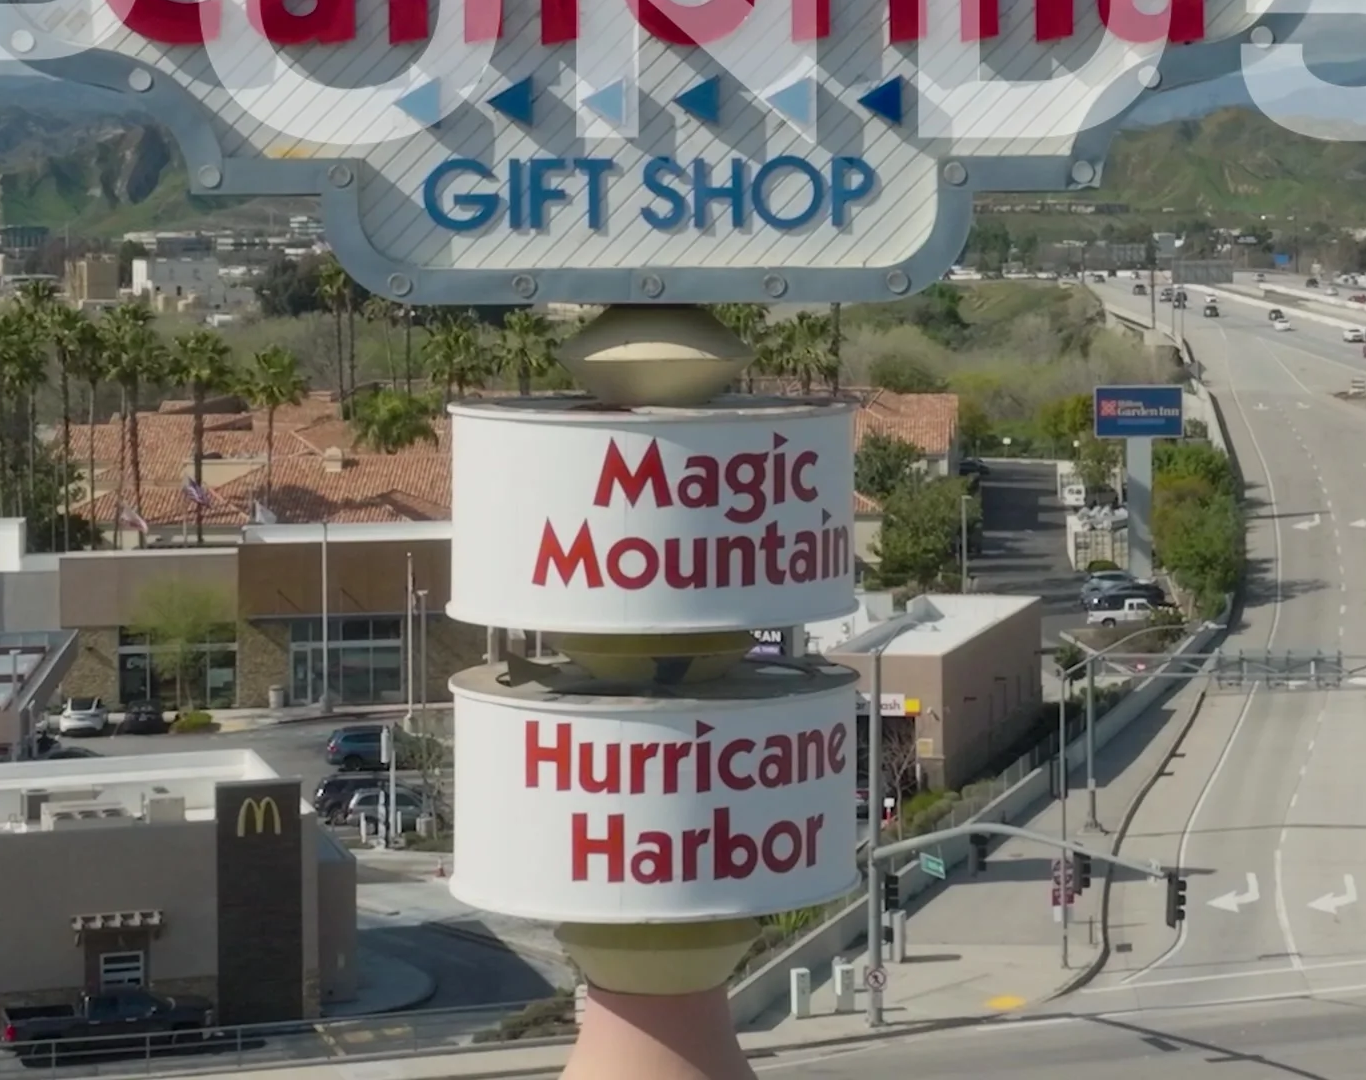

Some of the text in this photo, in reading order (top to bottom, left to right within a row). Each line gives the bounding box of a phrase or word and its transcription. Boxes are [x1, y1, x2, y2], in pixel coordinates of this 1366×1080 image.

[423, 155, 875, 231] GIFT SHOP
[1117, 406, 1180, 416] Garden Inn
[593, 431, 819, 524] Magic
[532, 507, 849, 590] Mountain
[525, 720, 847, 795] Hurricane
[572, 807, 824, 884] Harbor
